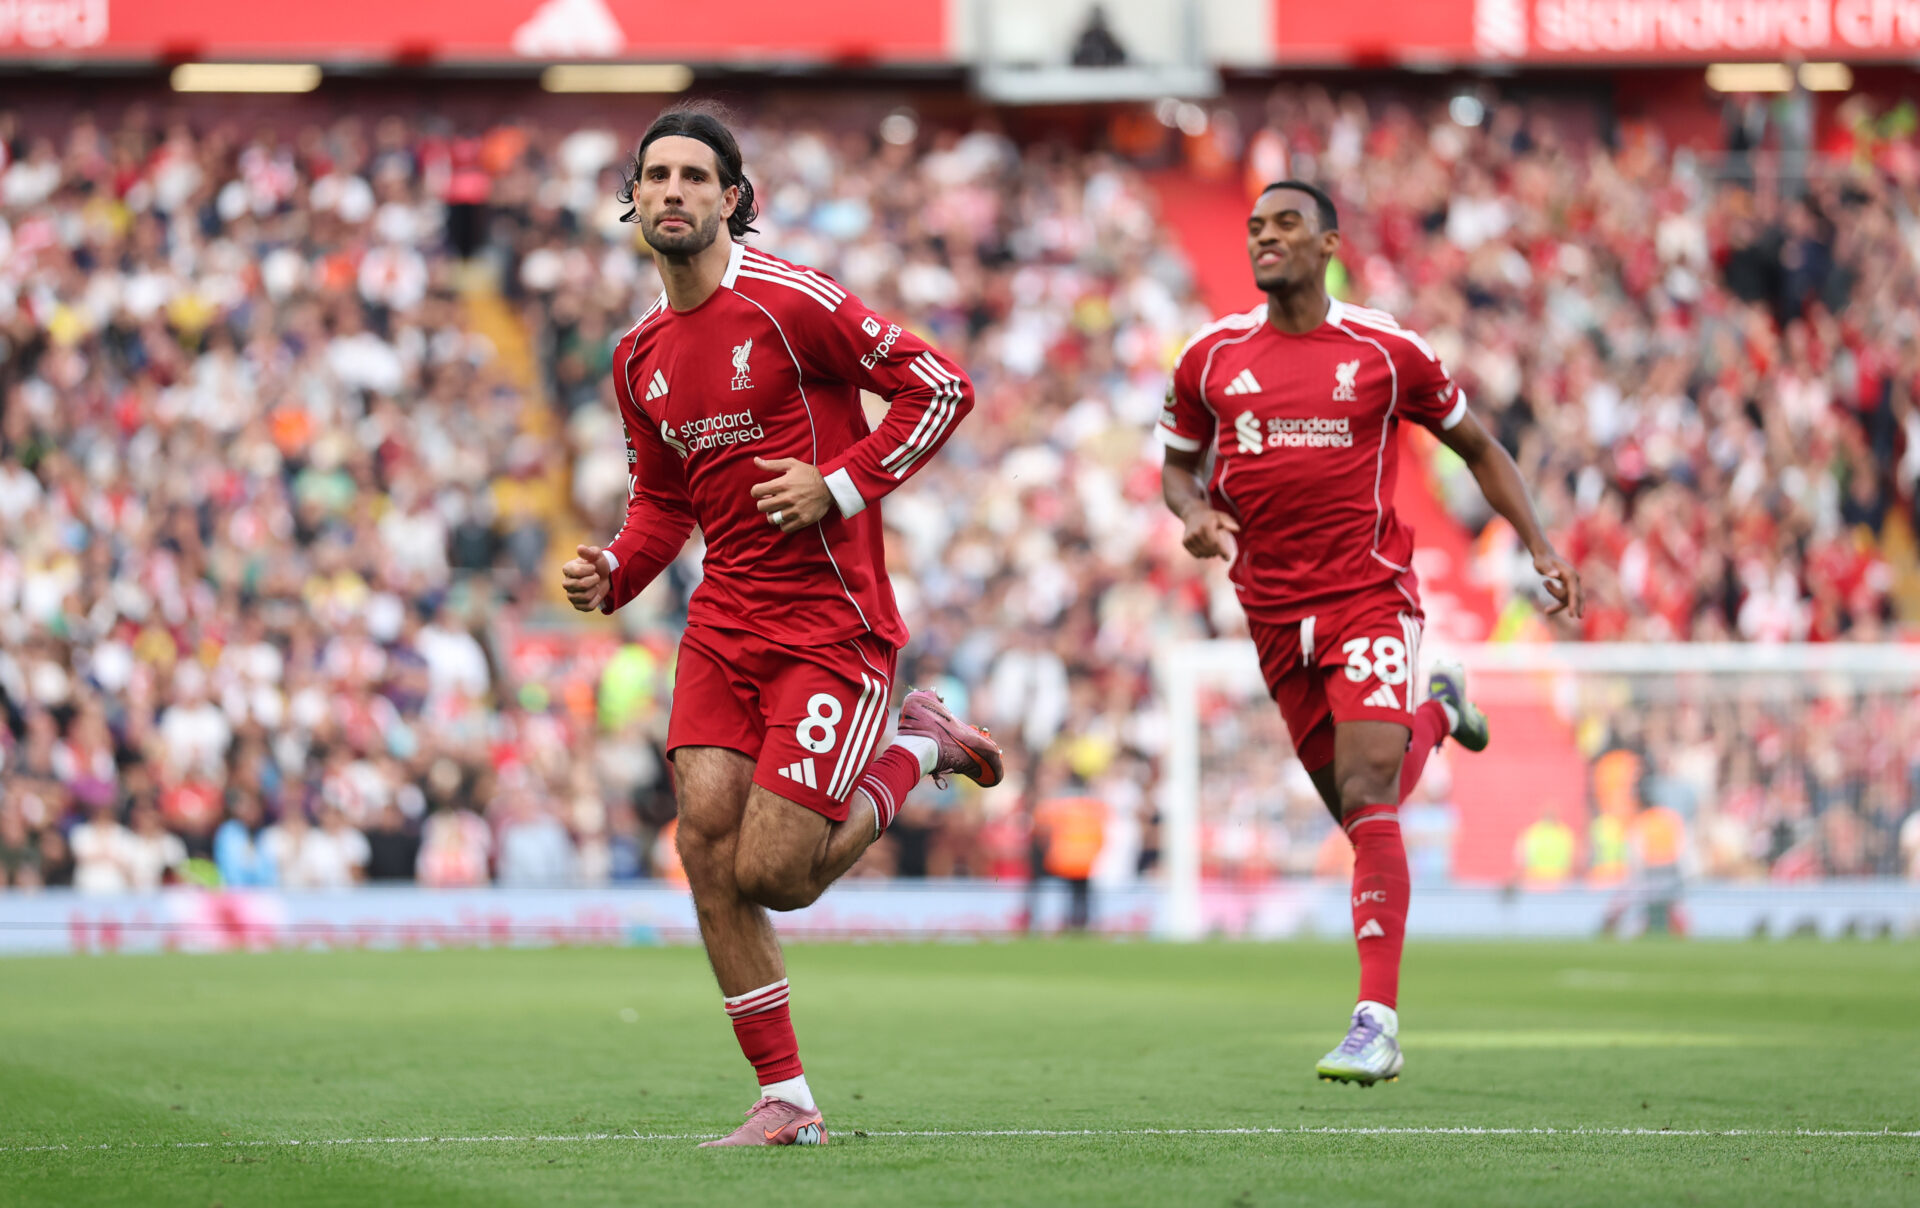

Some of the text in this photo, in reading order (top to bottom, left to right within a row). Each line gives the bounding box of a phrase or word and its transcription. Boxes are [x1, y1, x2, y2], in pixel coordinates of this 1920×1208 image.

[680, 409, 753, 438] standard
[1266, 416, 1349, 433] standard
[687, 424, 764, 452] chartered
[1267, 431, 1354, 448] chartered
[1342, 635, 1406, 685] 38
[796, 693, 843, 754] 8
[1352, 890, 1387, 908] LFC
